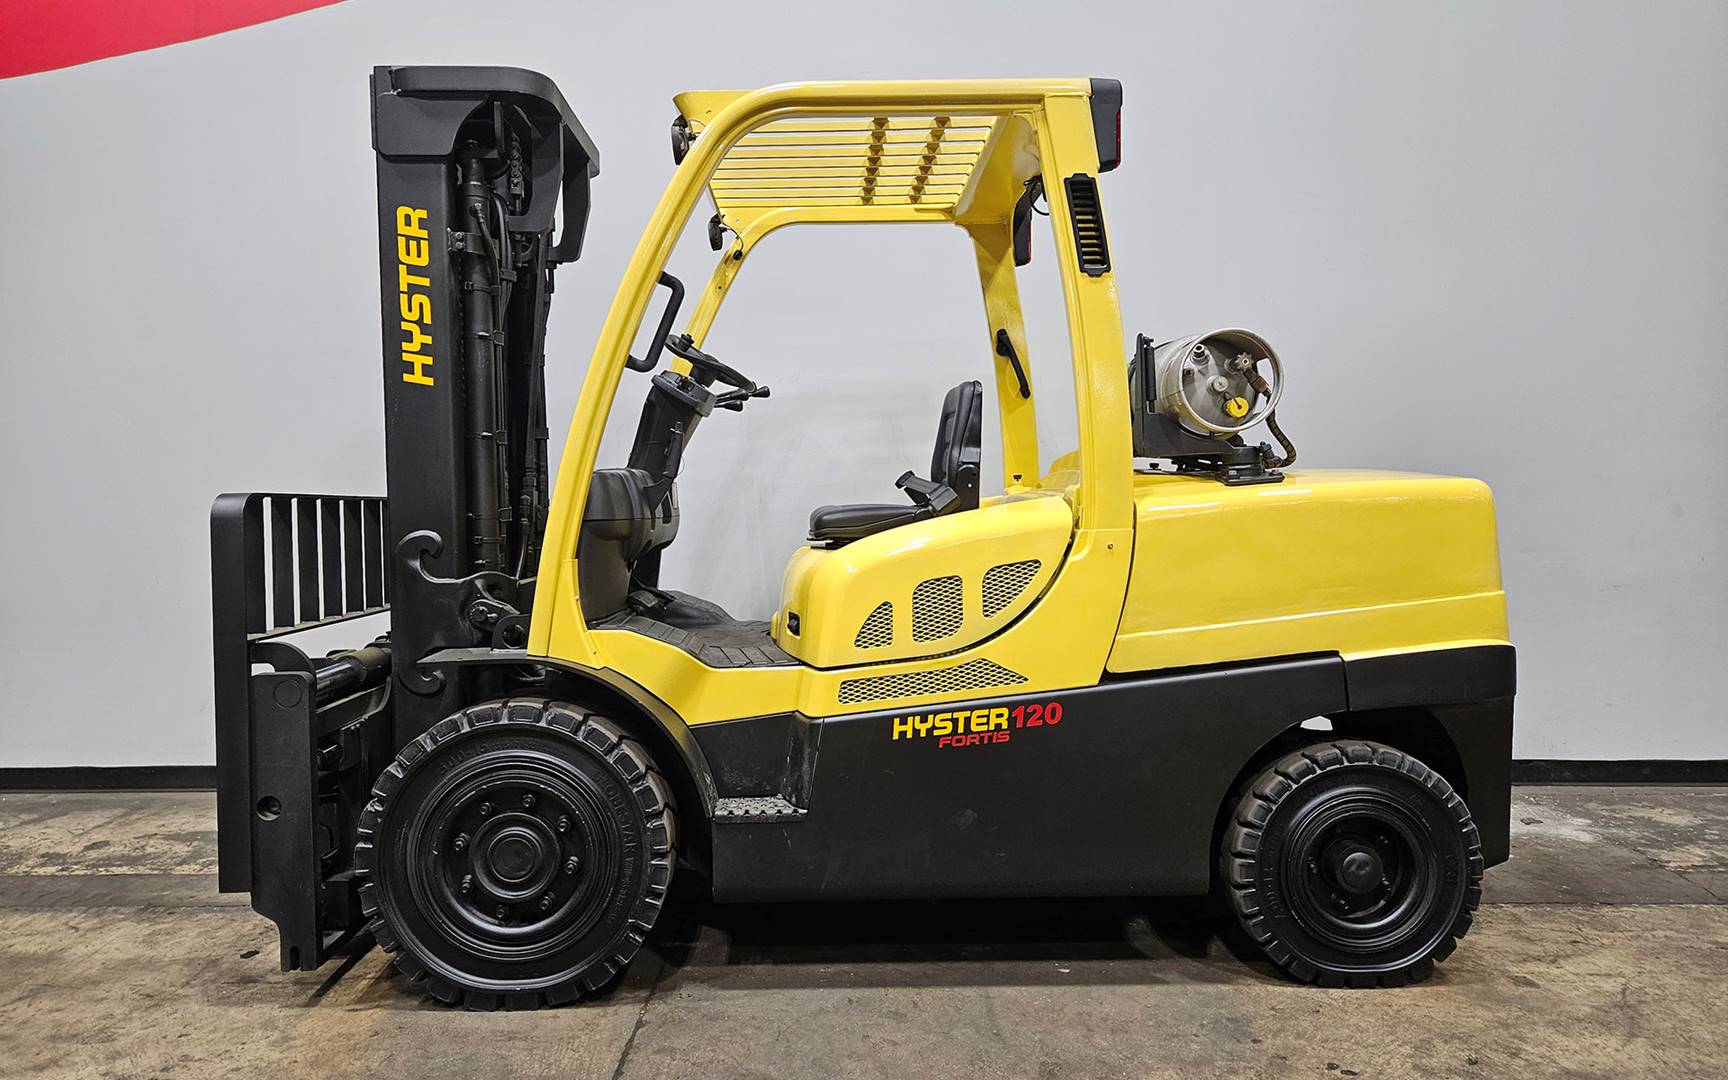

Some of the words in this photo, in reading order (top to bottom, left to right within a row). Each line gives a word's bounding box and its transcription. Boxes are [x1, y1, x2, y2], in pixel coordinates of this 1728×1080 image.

[397, 206, 434, 386] HYSTER
[892, 707, 1009, 740] HYSTER
[1011, 702, 1062, 728] 120
[938, 731, 1010, 748] FORTIS
